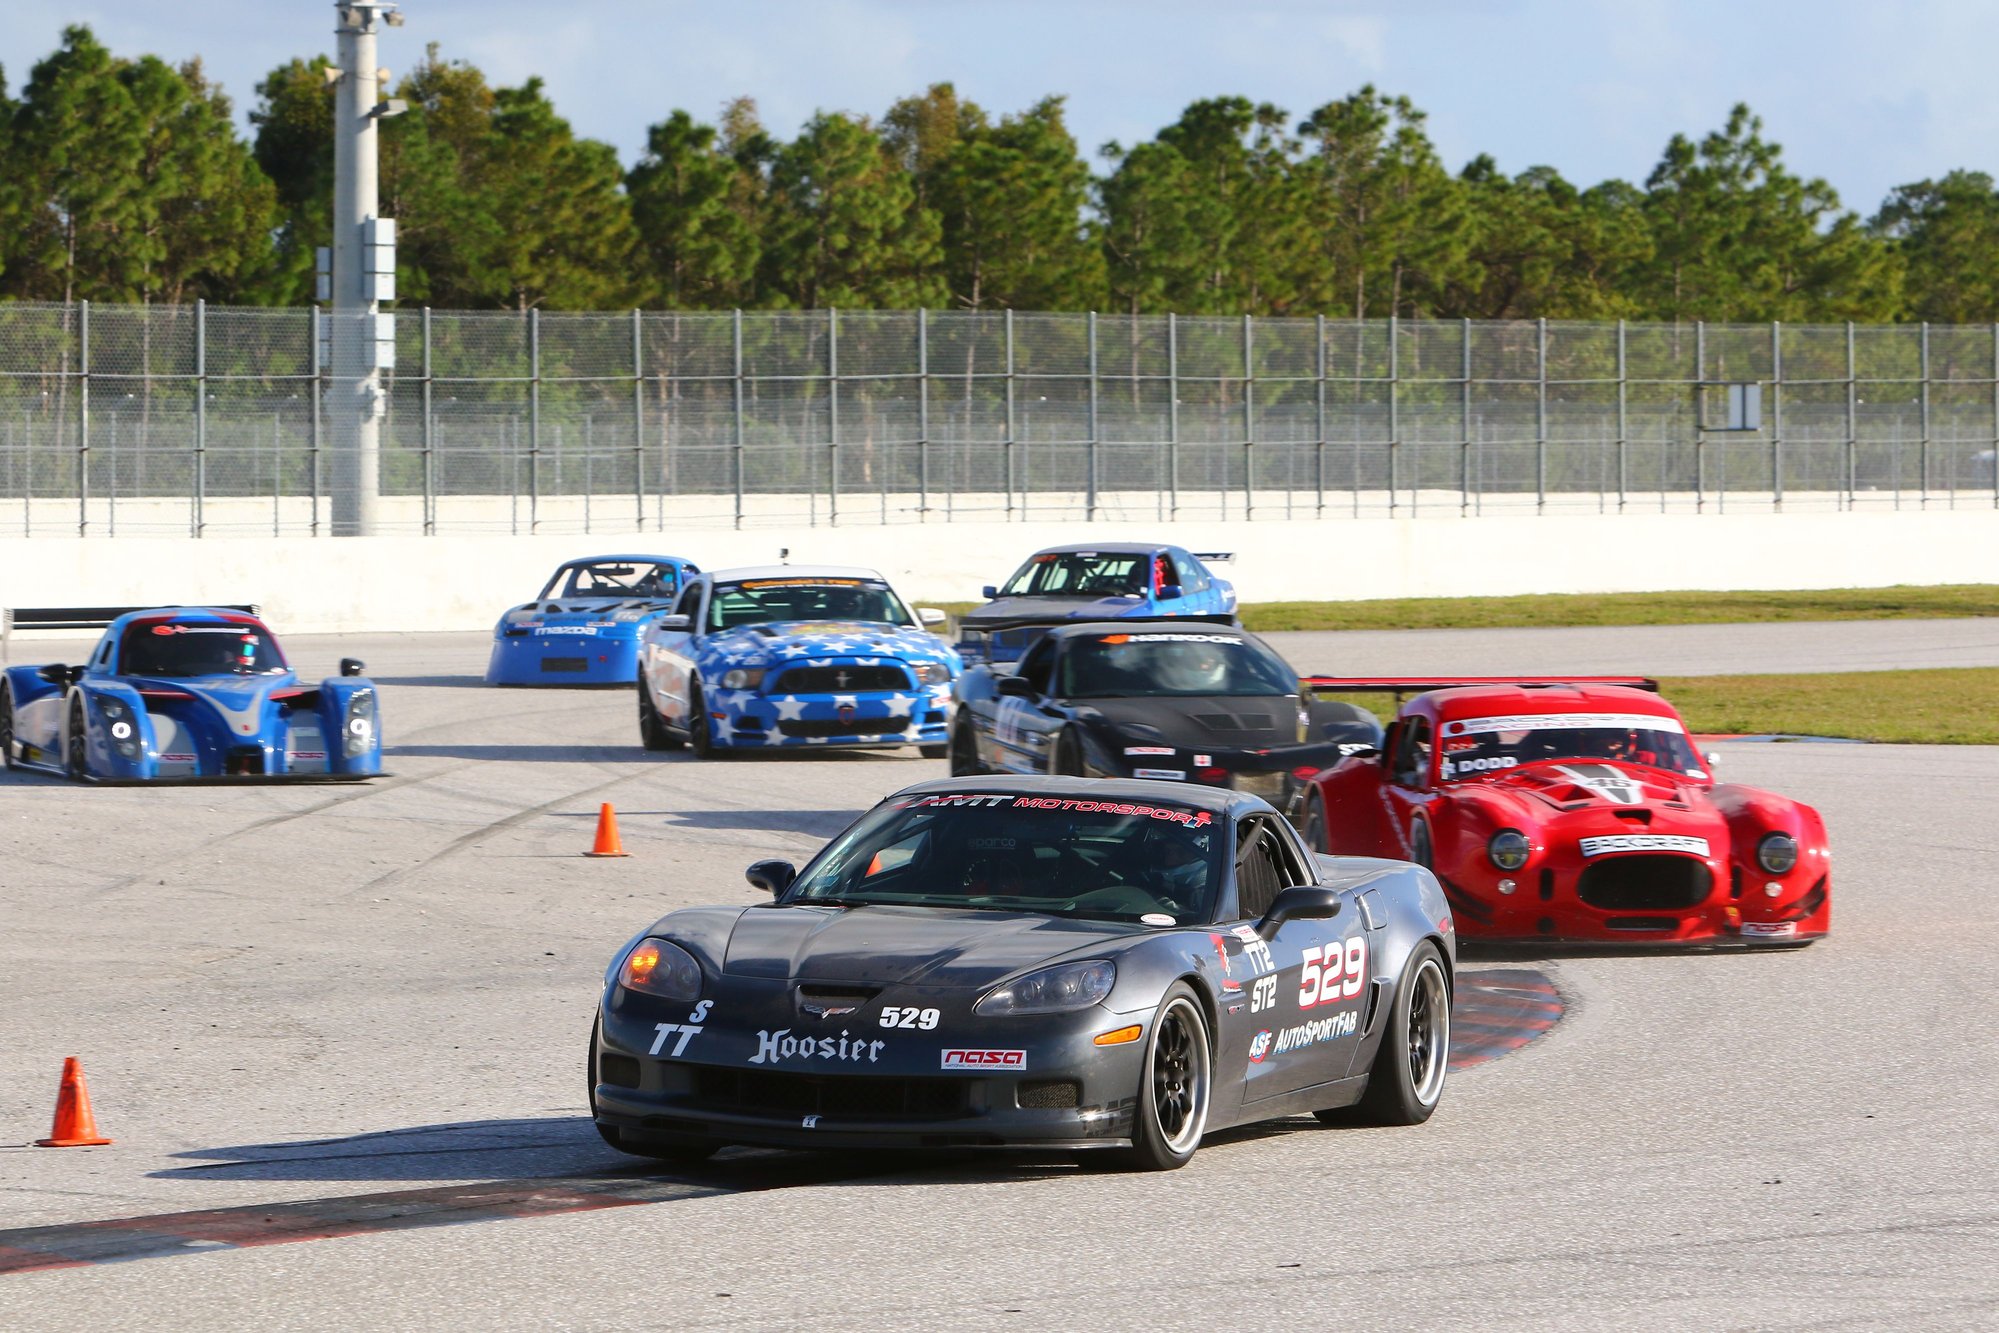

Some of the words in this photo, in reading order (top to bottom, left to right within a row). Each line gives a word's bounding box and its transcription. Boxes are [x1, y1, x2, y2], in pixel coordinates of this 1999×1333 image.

[534, 626, 597, 636] mazda
[1466, 721, 1592, 732] RACING
[1458, 756, 1518, 773] DODD
[905, 794, 1014, 809] AMT
[1013, 797, 1211, 828] MOTORSPORT
[1244, 940, 1275, 975] TT2
[1299, 936, 1366, 1010] 529
[1251, 974, 1278, 1014] ST2
[879, 1007, 941, 1030] 529
[649, 1023, 703, 1057] TT
[748, 1028, 886, 1064] Hoosier
[1249, 1033, 1272, 1057] ASF
[944, 1050, 1023, 1064] nasa
